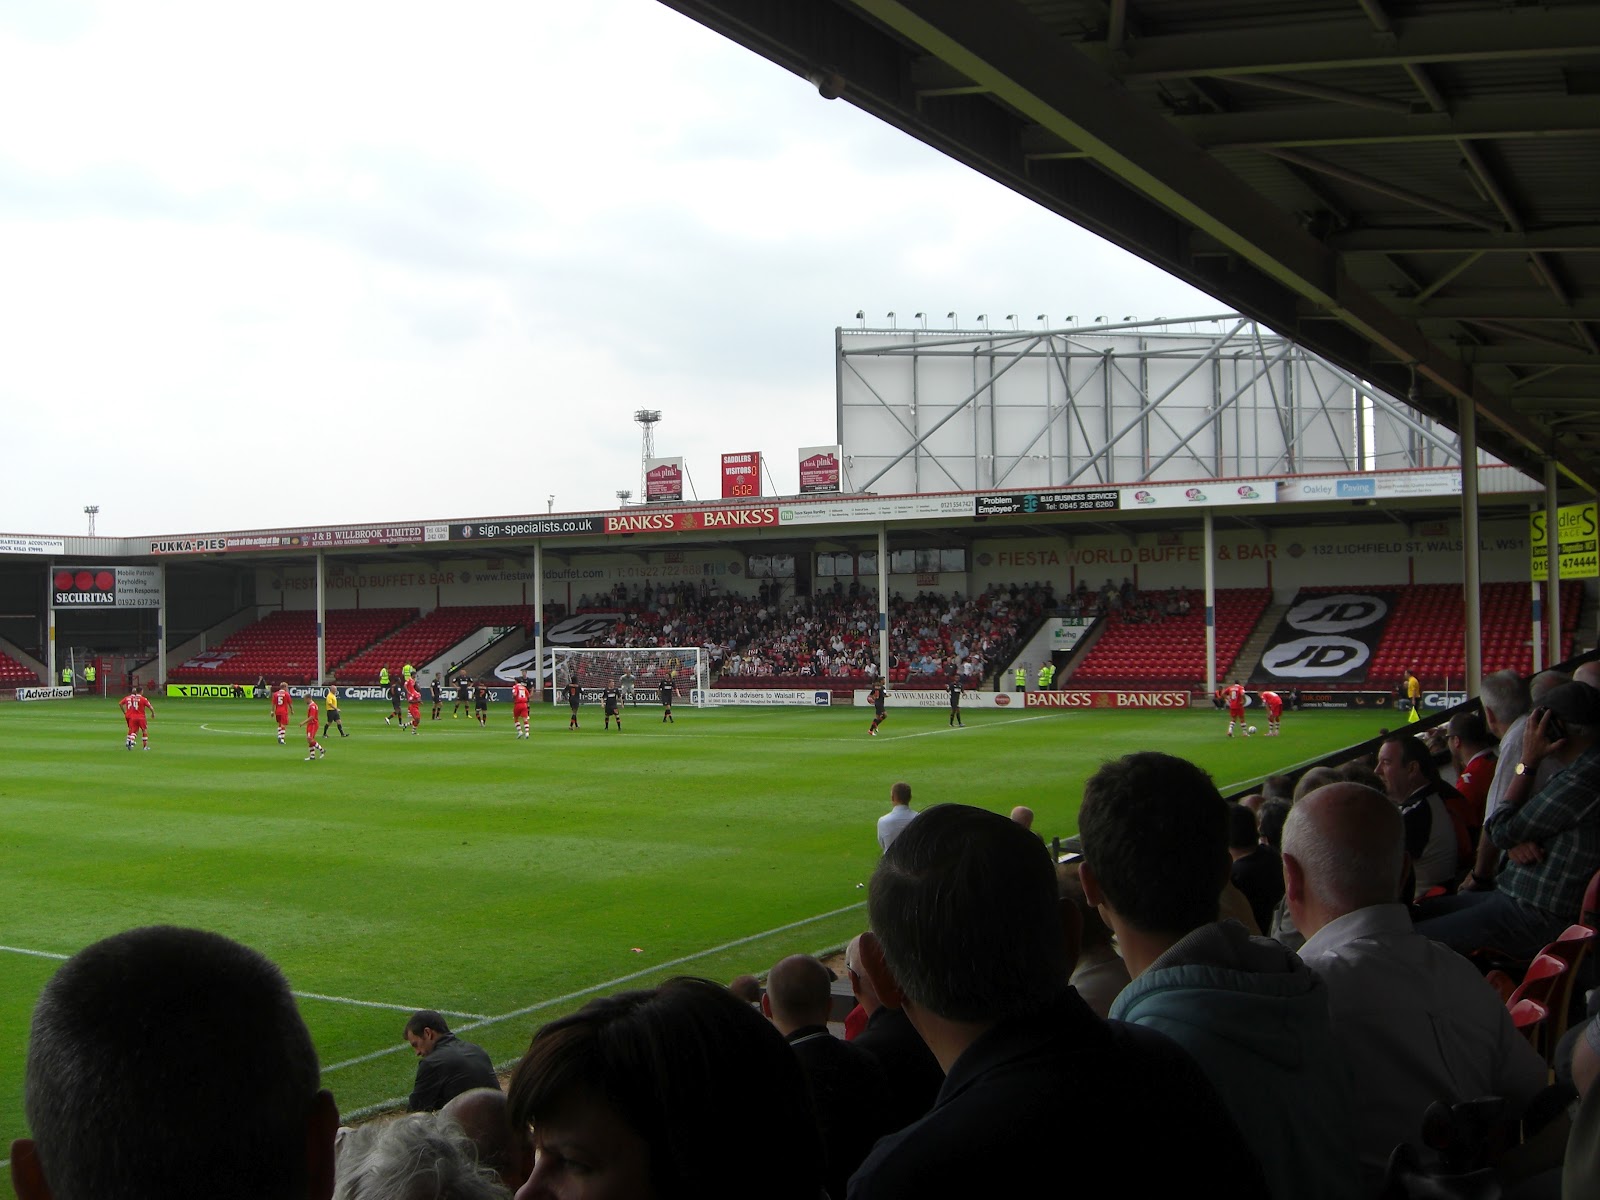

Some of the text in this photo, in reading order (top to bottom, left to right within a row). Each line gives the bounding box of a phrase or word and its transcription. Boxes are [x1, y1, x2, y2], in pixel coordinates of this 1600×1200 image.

[723, 455, 751, 464] SADDLERS
[725, 466, 751, 476] VISITORS
[1303, 482, 1370, 494] Oakley Paving
[981, 497, 1012, 505] "Problem
[1055, 494, 1085, 502] BUSINESS
[1087, 492, 1118, 500] SERVICES
[978, 504, 1020, 515] Employee?"
[1046, 500, 1114, 511] Tel: 0845 262 6260
[608, 514, 674, 531] BANKS'S
[704, 508, 773, 527] BANKS'S
[318, 533, 325, 541] &
[335, 528, 382, 540] WILLBROOK
[386, 527, 421, 537] LIMITED
[479, 518, 592, 538] sign-specialists.co.uk
[151, 538, 227, 552] PUKKA-PIES
[1313, 545, 1333, 555] 132
[1336, 542, 1402, 554] LICHFIELD
[1496, 539, 1524, 550] WS1
[999, 550, 1060, 567] FIESTA
[1067, 545, 1133, 565] WORLD
[1217, 545, 1230, 560] &
[1237, 543, 1278, 561] BAR
[1562, 556, 1597, 569] 474444
[285, 571, 454, 590] FIEST WORLD BUFFET & BAR
[475, 568, 604, 582] www.fiestawldbuffet.com
[117, 579, 147, 587] Keyholding
[56, 592, 114, 604] SECURITAS
[135, 588, 160, 596] Response
[118, 598, 160, 606] 01922 637 394
[1296, 602, 1377, 624] JD
[1273, 645, 1358, 668] JD
[25, 689, 72, 699] Advertiser
[1027, 693, 1185, 706] BANKS'S BANKS'S
[277, 697, 284, 706] 5
